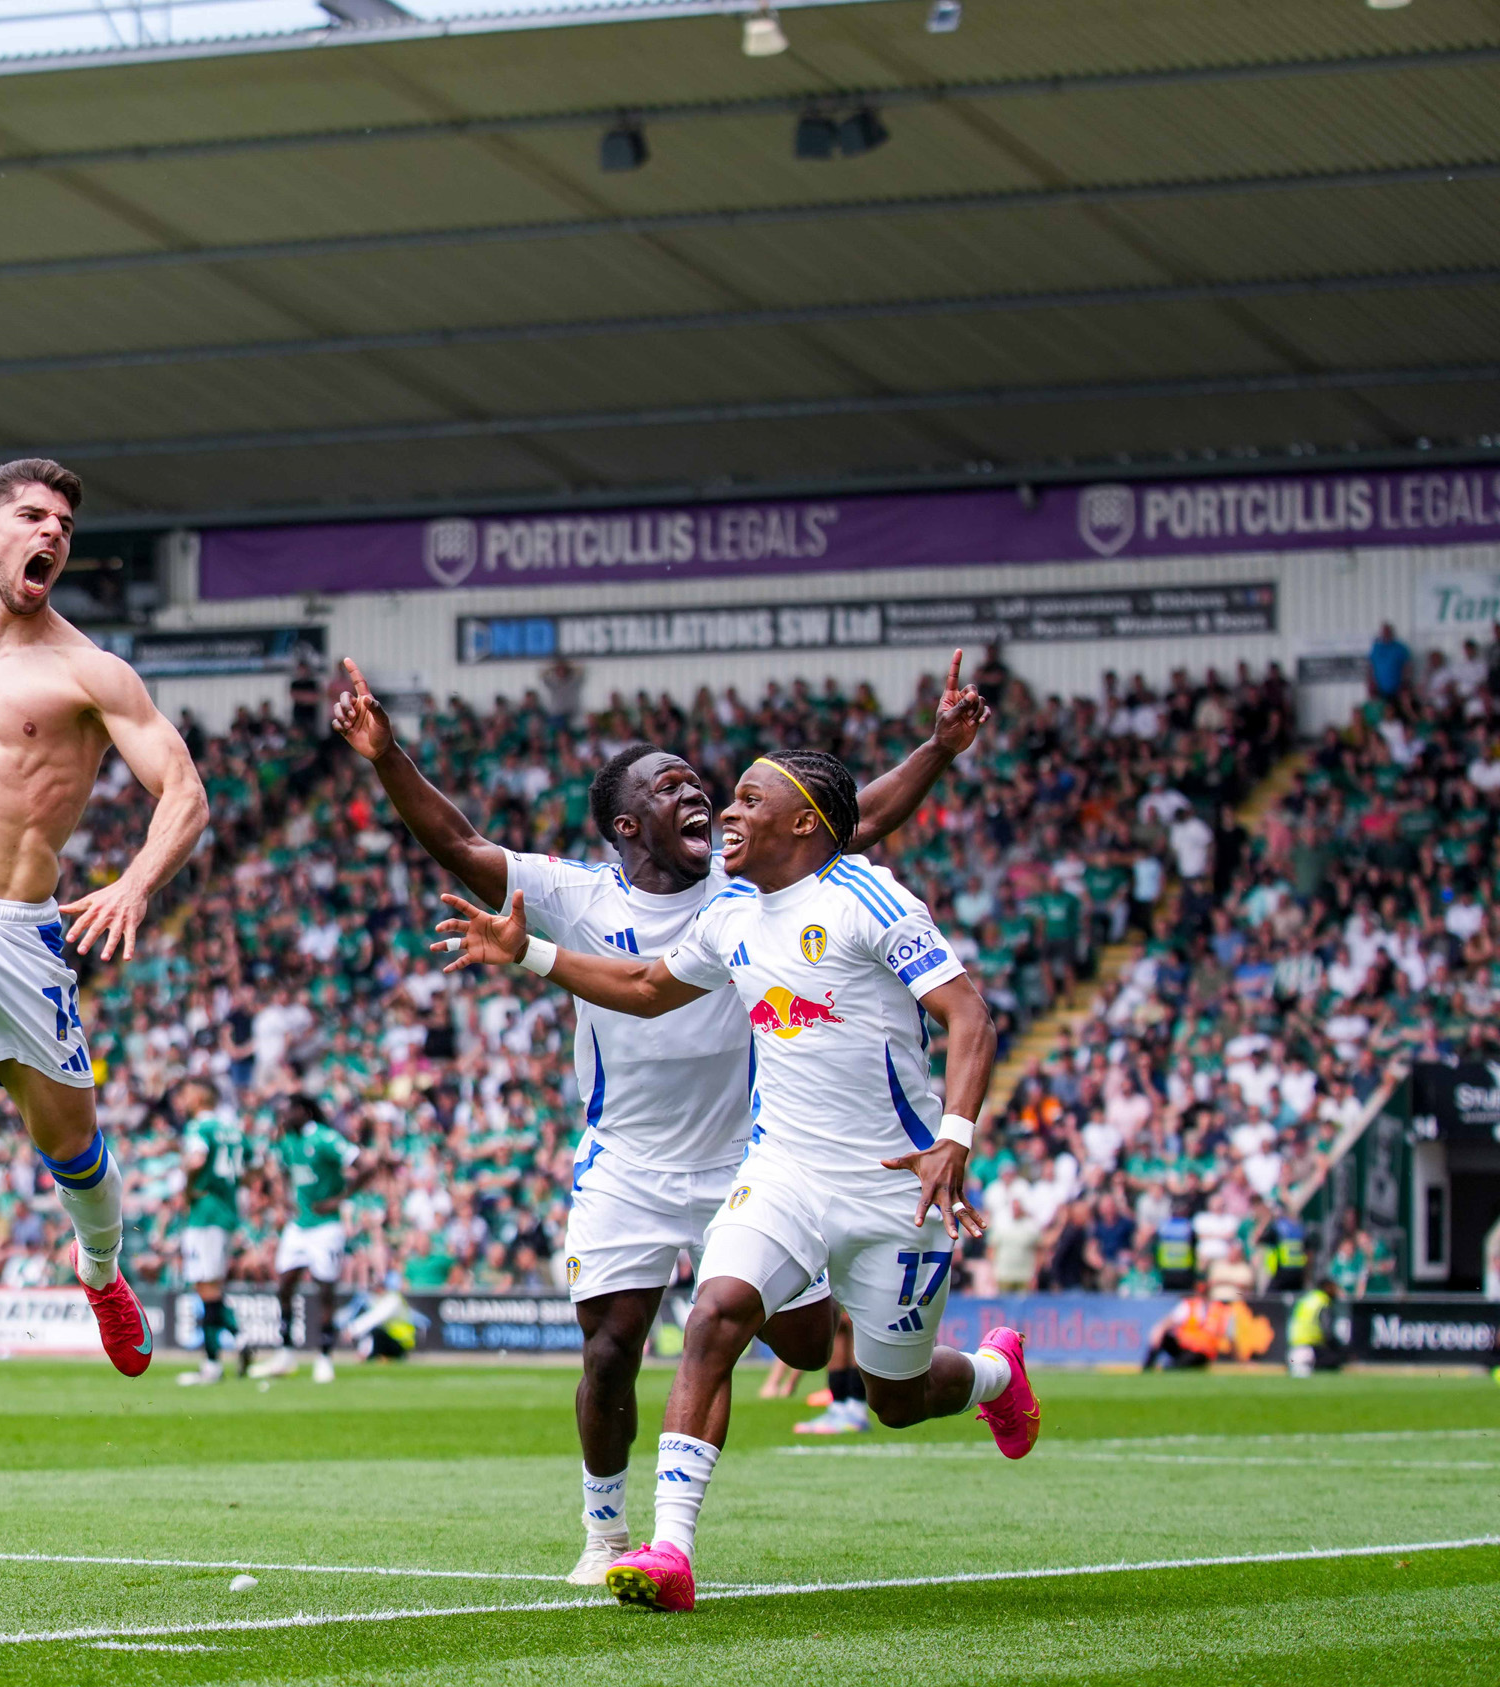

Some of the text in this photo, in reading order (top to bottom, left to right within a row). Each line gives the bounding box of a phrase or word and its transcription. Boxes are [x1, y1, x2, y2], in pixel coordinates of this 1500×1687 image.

[1143, 479, 1374, 541] PORTCULLIS
[482, 507, 830, 572] PORTCULLIS LEGALS
[558, 608, 773, 655] INSTALLATIONS
[886, 930, 936, 970] BOXT
[904, 952, 942, 980] LIFE
[897, 1251, 954, 1306] 17
[981, 1310, 1141, 1351] Builders
